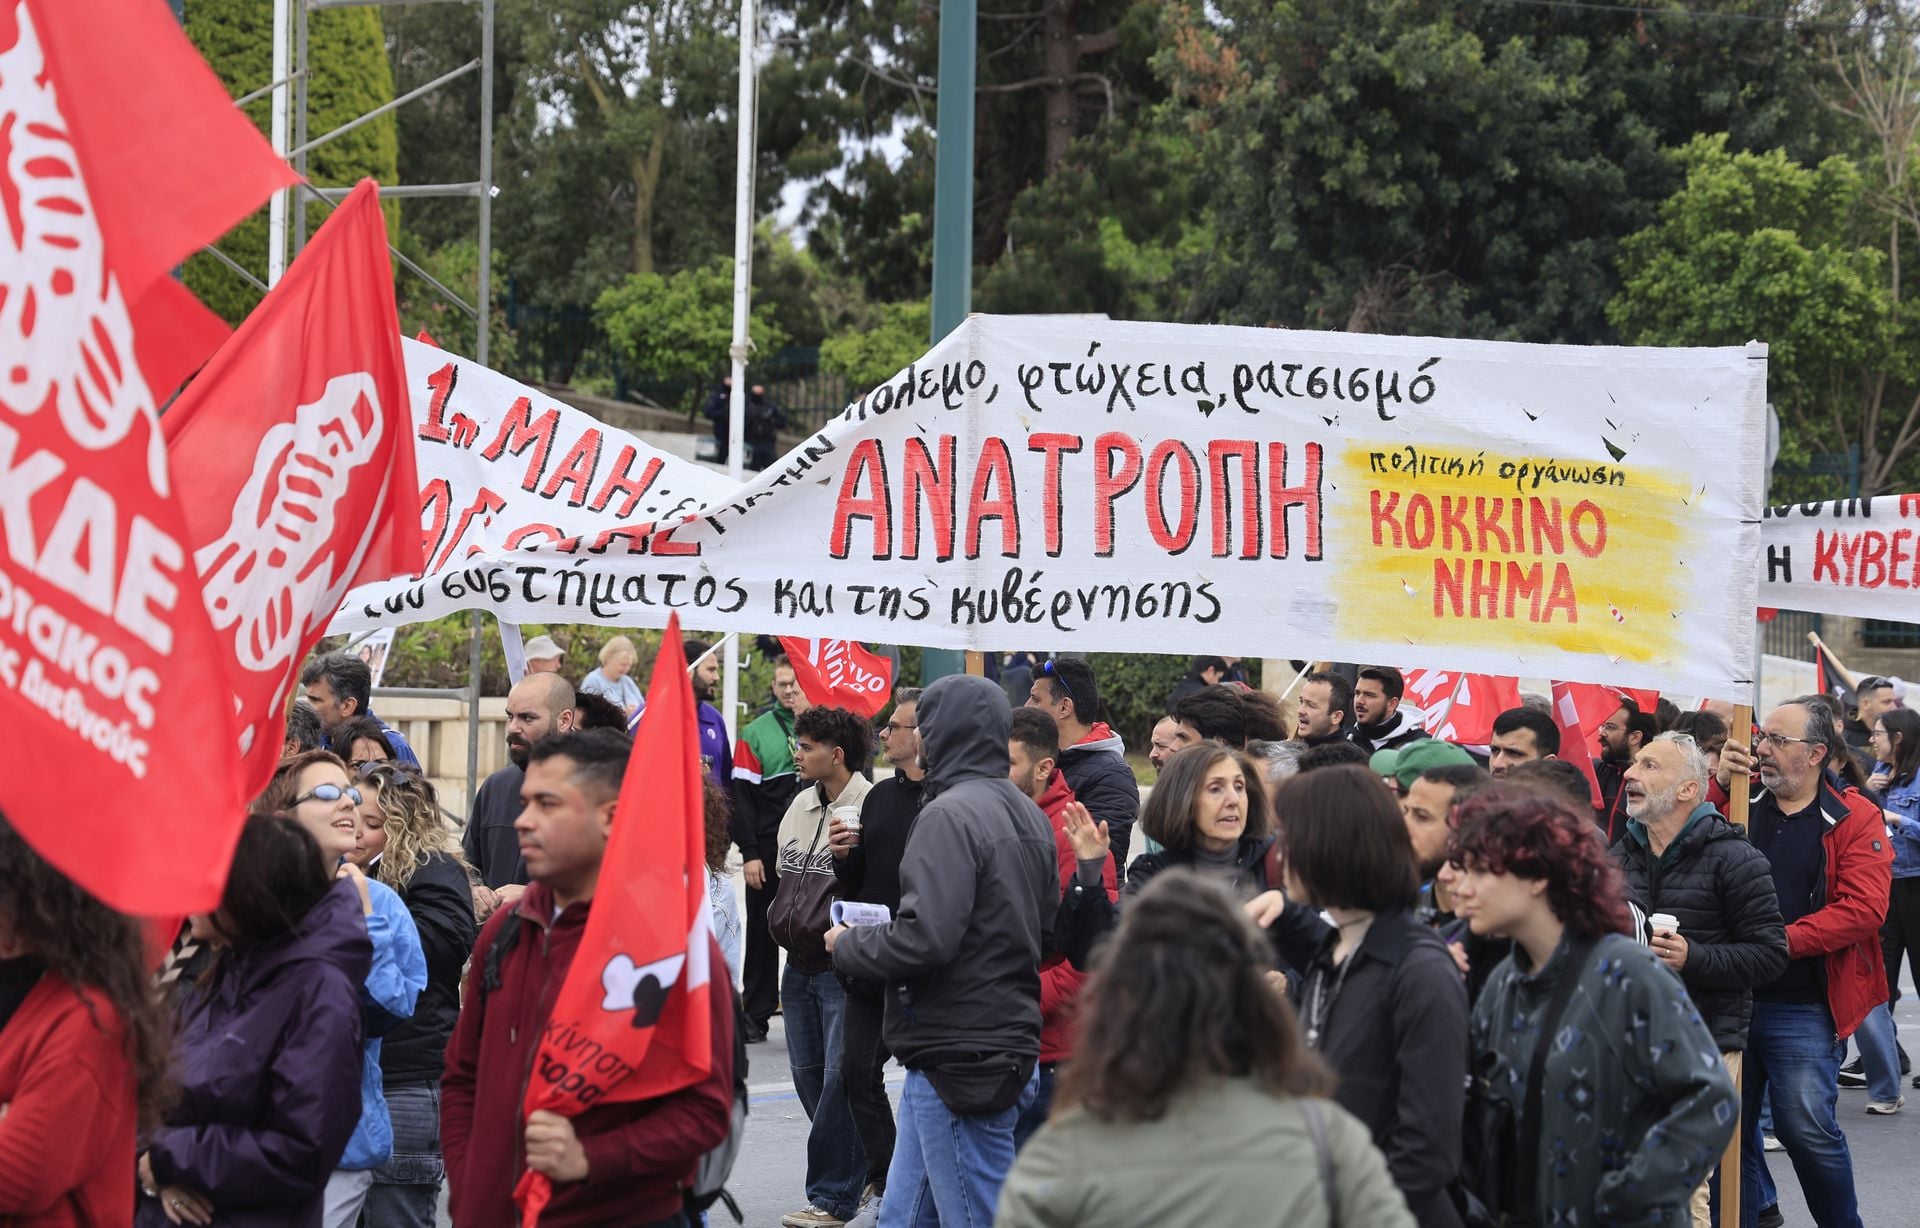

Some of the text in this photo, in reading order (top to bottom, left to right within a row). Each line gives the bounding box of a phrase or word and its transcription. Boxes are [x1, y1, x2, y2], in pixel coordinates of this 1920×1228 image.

[829, 431, 1324, 562] ΑΝΑΤΡΟΠΗ
[1370, 446, 1626, 494] πολιτική οργάνωση
[1370, 488, 1608, 559] ΚΟΚΚΙΝΟ
[1433, 557, 1578, 625] ΝΗΜΑ
[1813, 527, 1920, 590] ΚΥΒΕ
[440, 557, 749, 619] συστήματος
[773, 575, 833, 619] και
[846, 580, 931, 621] της
[950, 566, 1222, 632] κυβέρνησης
